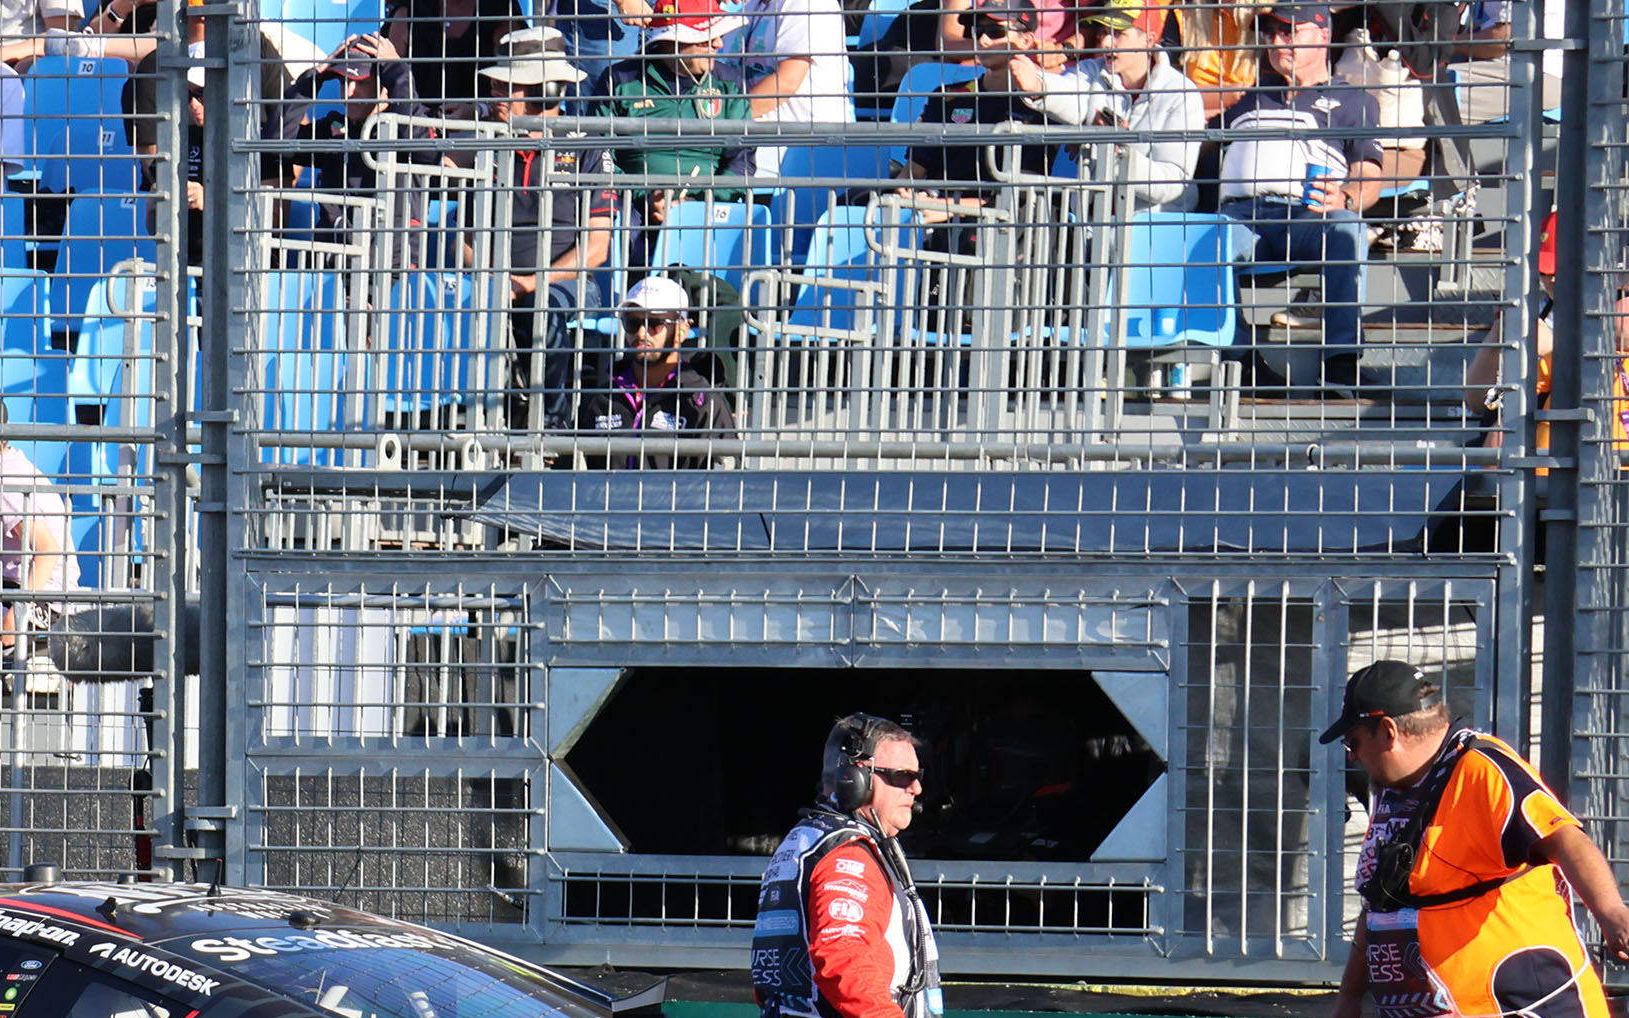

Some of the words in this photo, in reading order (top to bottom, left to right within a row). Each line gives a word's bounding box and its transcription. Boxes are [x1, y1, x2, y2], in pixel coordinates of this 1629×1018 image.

[831, 901, 861, 919] FIA
[190, 928, 454, 962] Steadfast
[1367, 943, 1402, 961] RSE
[112, 948, 221, 997] AUTODESK
